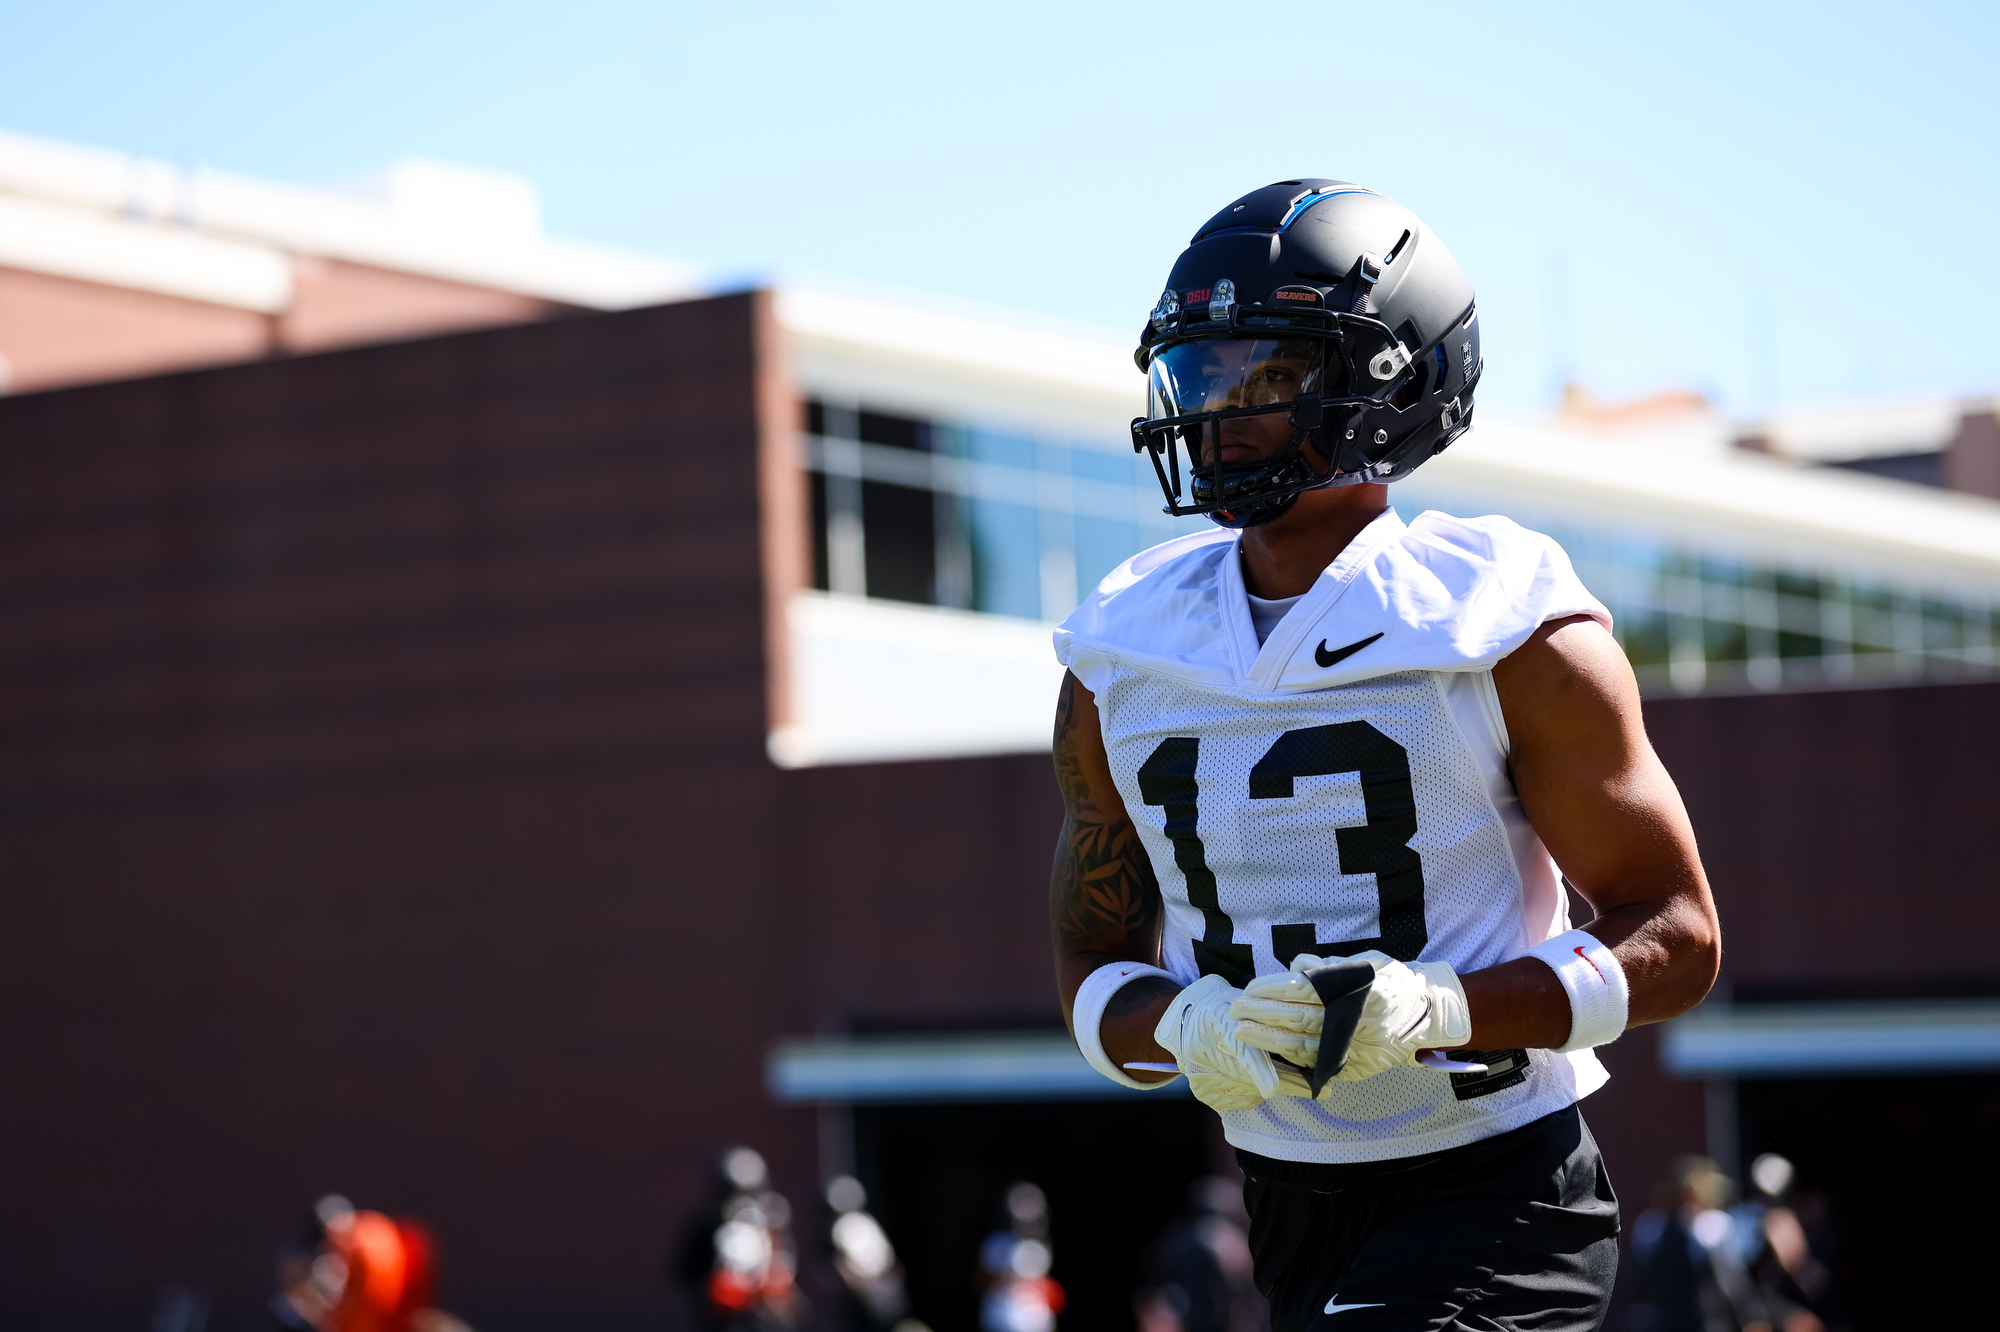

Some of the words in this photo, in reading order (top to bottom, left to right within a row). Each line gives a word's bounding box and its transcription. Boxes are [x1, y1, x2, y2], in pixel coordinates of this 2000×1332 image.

[1187, 288, 1211, 304] OSU
[1276, 291, 1317, 302] BEAVERS
[1137, 719, 1429, 987] 13
